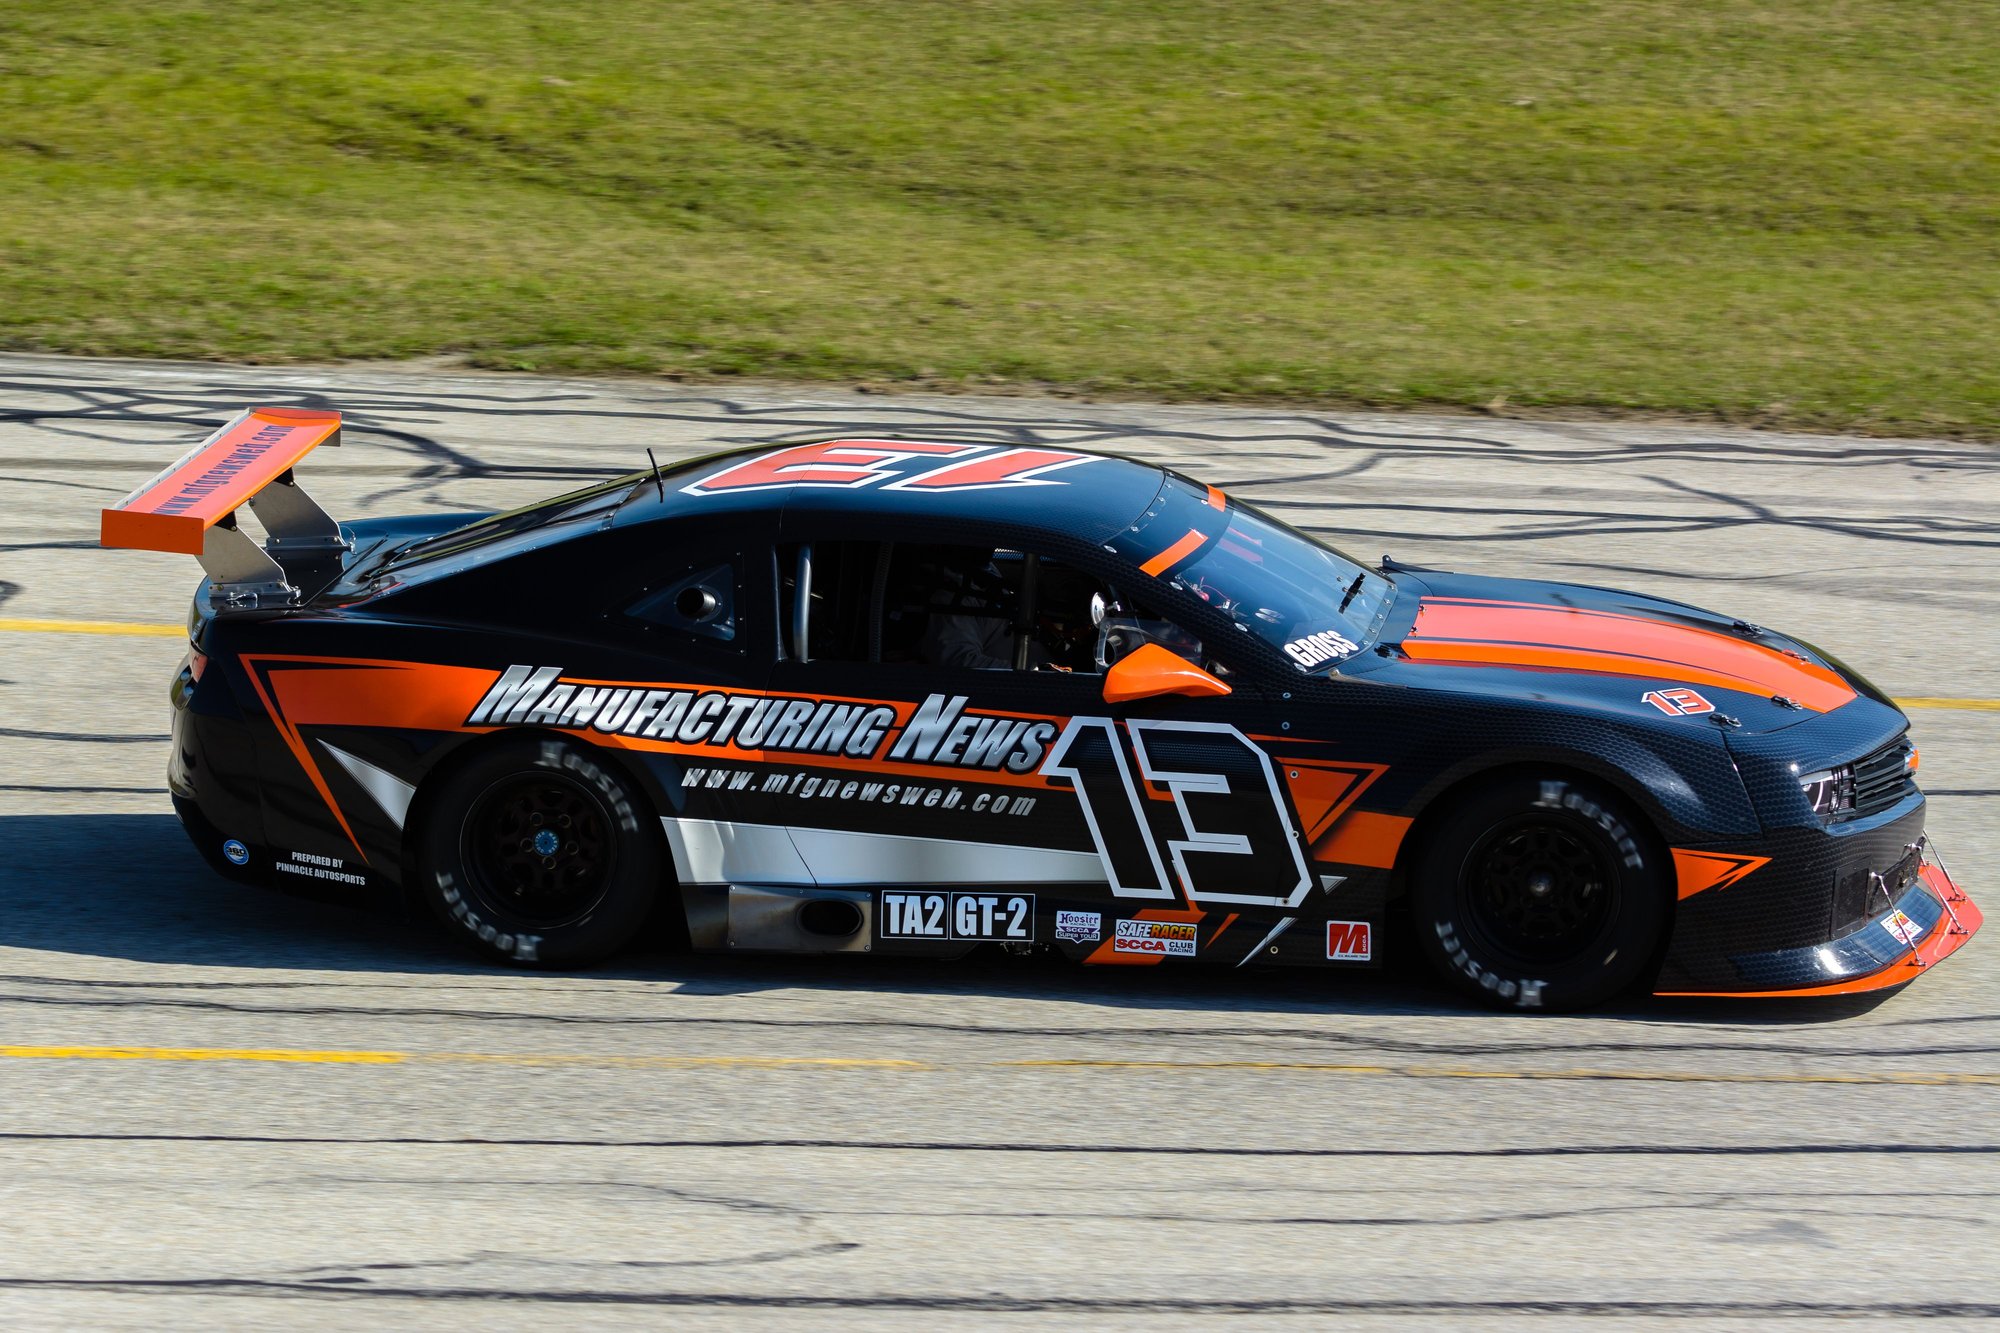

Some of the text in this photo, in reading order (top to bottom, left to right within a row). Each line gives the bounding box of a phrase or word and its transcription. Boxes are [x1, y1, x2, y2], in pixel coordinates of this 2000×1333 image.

[1283, 630, 1359, 667] GROSS
[1641, 687, 1716, 716] 13
[888, 693, 1056, 771] NEWS
[681, 767, 1037, 817] www.mfgnewsweb.com
[1038, 715, 1313, 908] 13
[276, 861, 366, 886] PINNACLE AUTOSPORTS
[291, 851, 344, 869] PREPARED BY
[885, 894, 945, 935] TA2
[955, 896, 1028, 937] GT-2
[1059, 913, 1099, 924] Hoosier
[1116, 939, 1167, 952] SCCA
